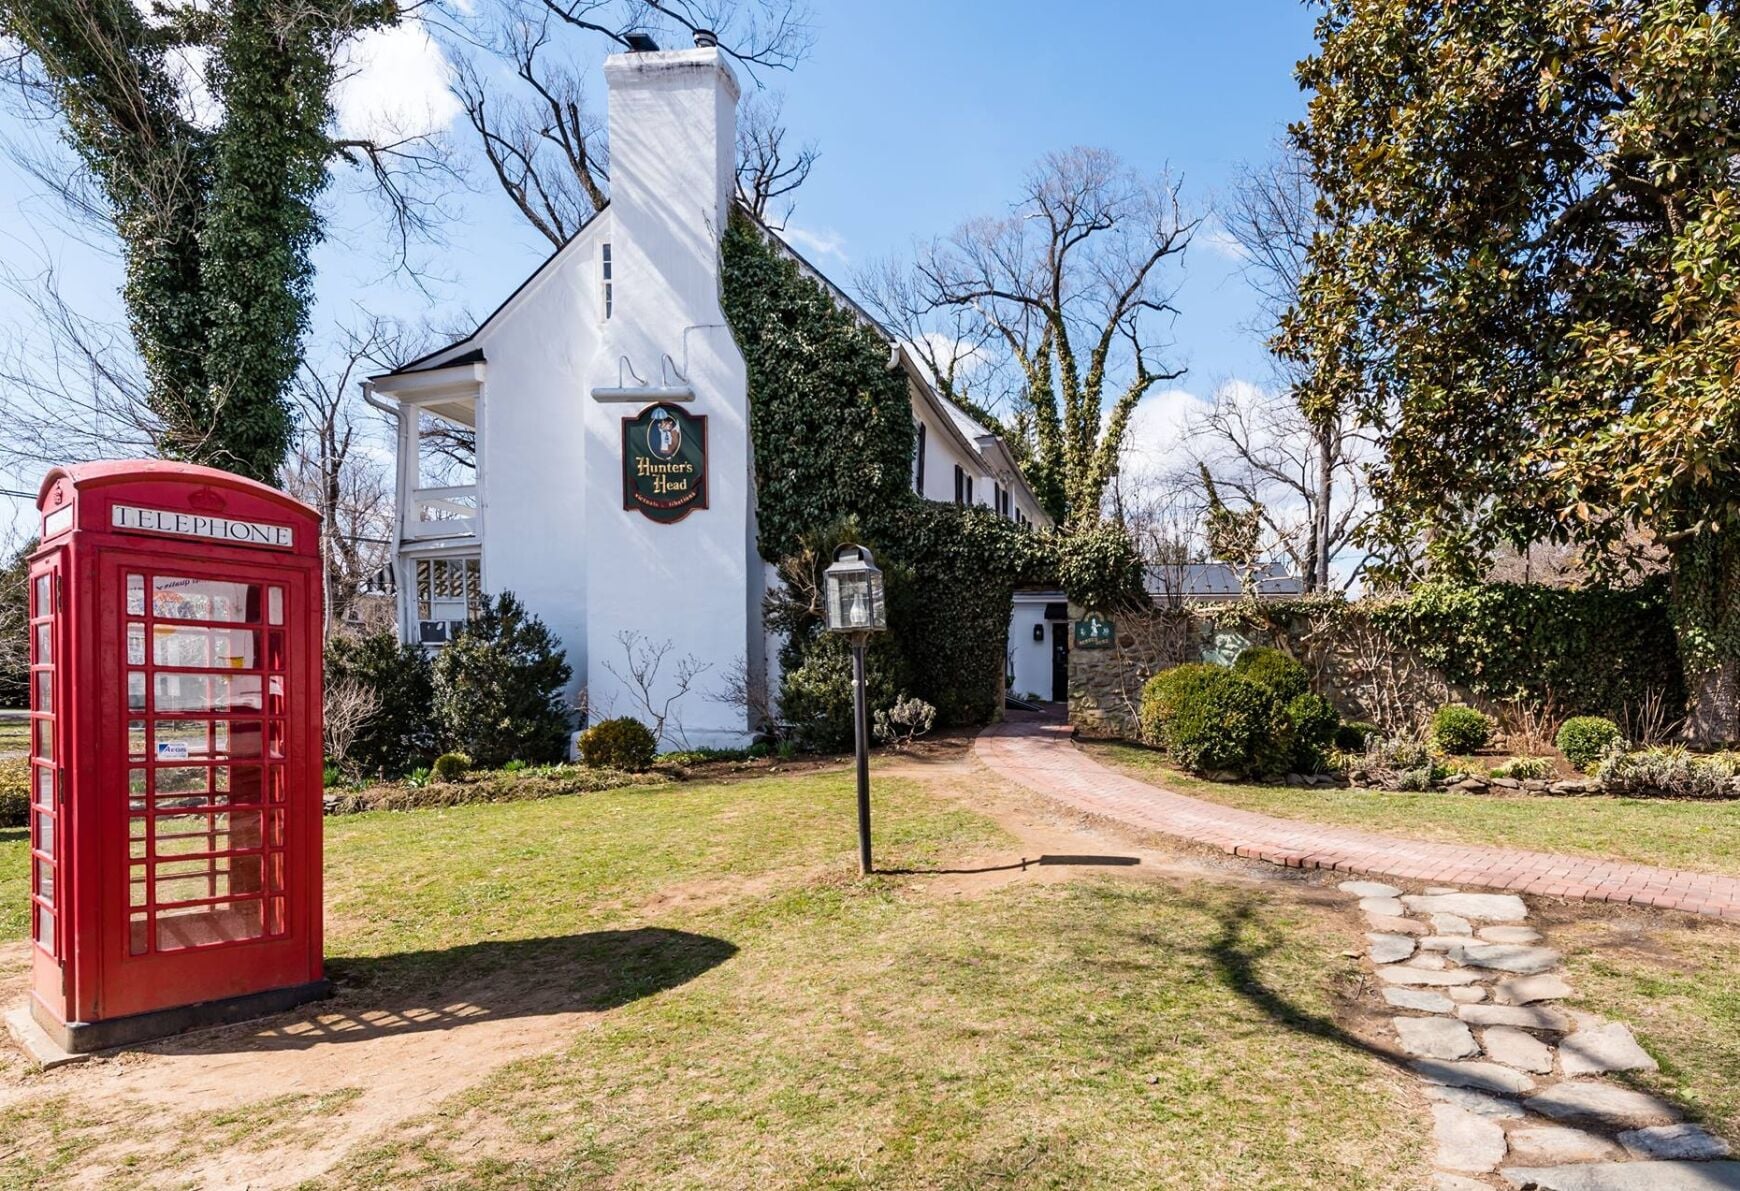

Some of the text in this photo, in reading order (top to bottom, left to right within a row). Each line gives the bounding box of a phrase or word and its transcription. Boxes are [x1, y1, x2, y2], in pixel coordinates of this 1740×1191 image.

[635, 457, 693, 476] Hunter's
[652, 474, 687, 494] Head
[116, 506, 289, 545] TELEPHONE
